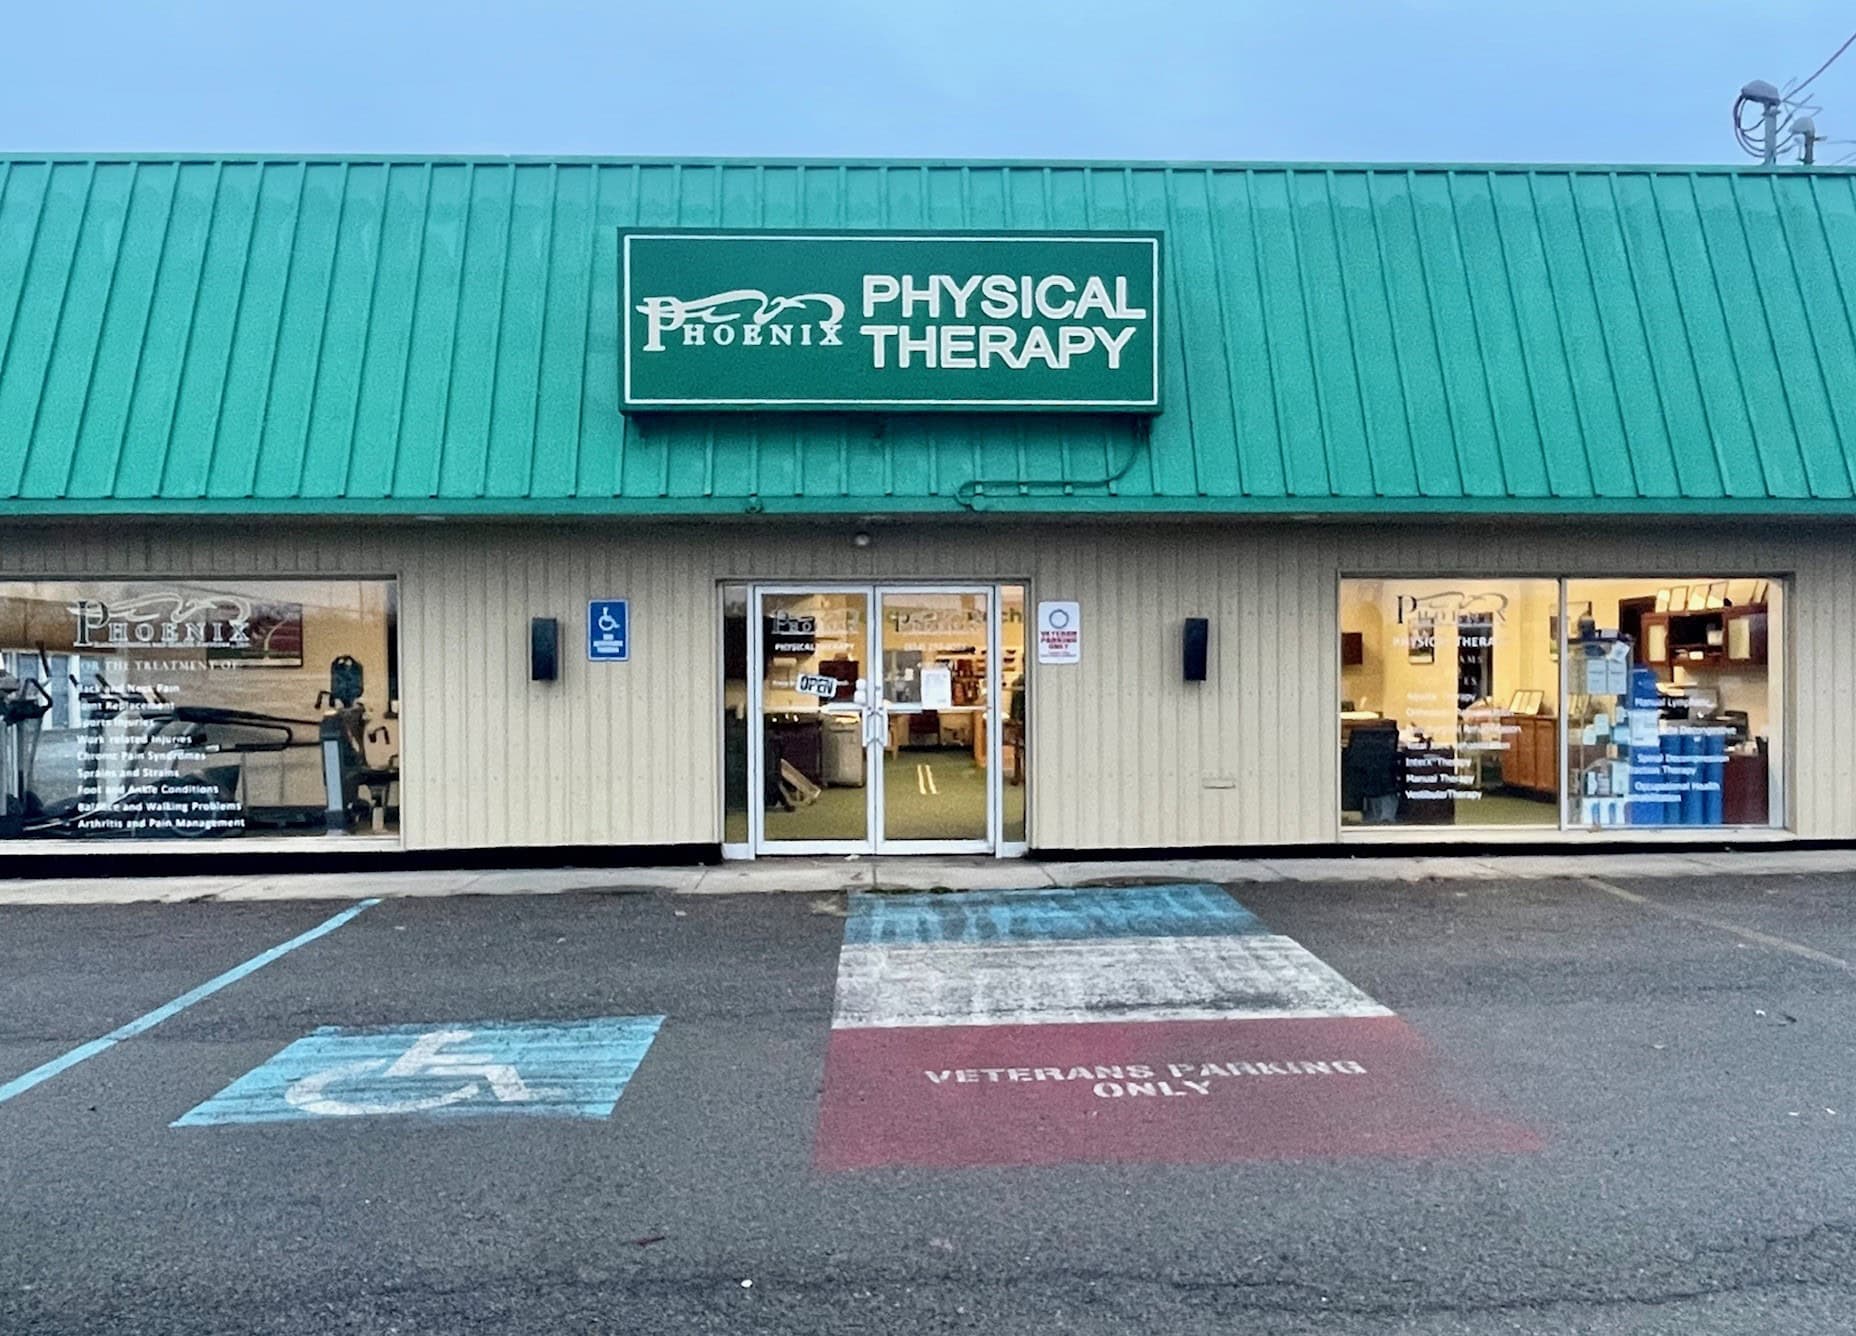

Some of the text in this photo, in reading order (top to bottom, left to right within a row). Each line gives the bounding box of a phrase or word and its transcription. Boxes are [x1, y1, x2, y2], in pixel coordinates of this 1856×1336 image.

[863, 274, 1146, 320] PHYSICAL
[640, 294, 846, 352] PHOENIX
[860, 325, 1137, 369] THERAPY
[73, 600, 251, 647] PHOENIX
[156, 684, 180, 693] Pain
[800, 676, 835, 695] OPEN
[105, 702, 176, 713] Replacement
[77, 735, 105, 744] Work
[121, 751, 146, 761] Pain
[147, 751, 207, 763] Syndromes
[77, 769, 180, 780] Sprains and Strains
[77, 785, 102, 795] Foot
[160, 784, 220, 795] Conditions
[123, 803, 143, 812] and
[146, 802, 189, 814] Walking
[191, 802, 242, 812] Problems
[77, 819, 246, 831] Arthritis and Pain Management
[924, 1060, 1368, 1084] VETERANS PARKING
[1093, 1080, 1211, 1099] ONLY
